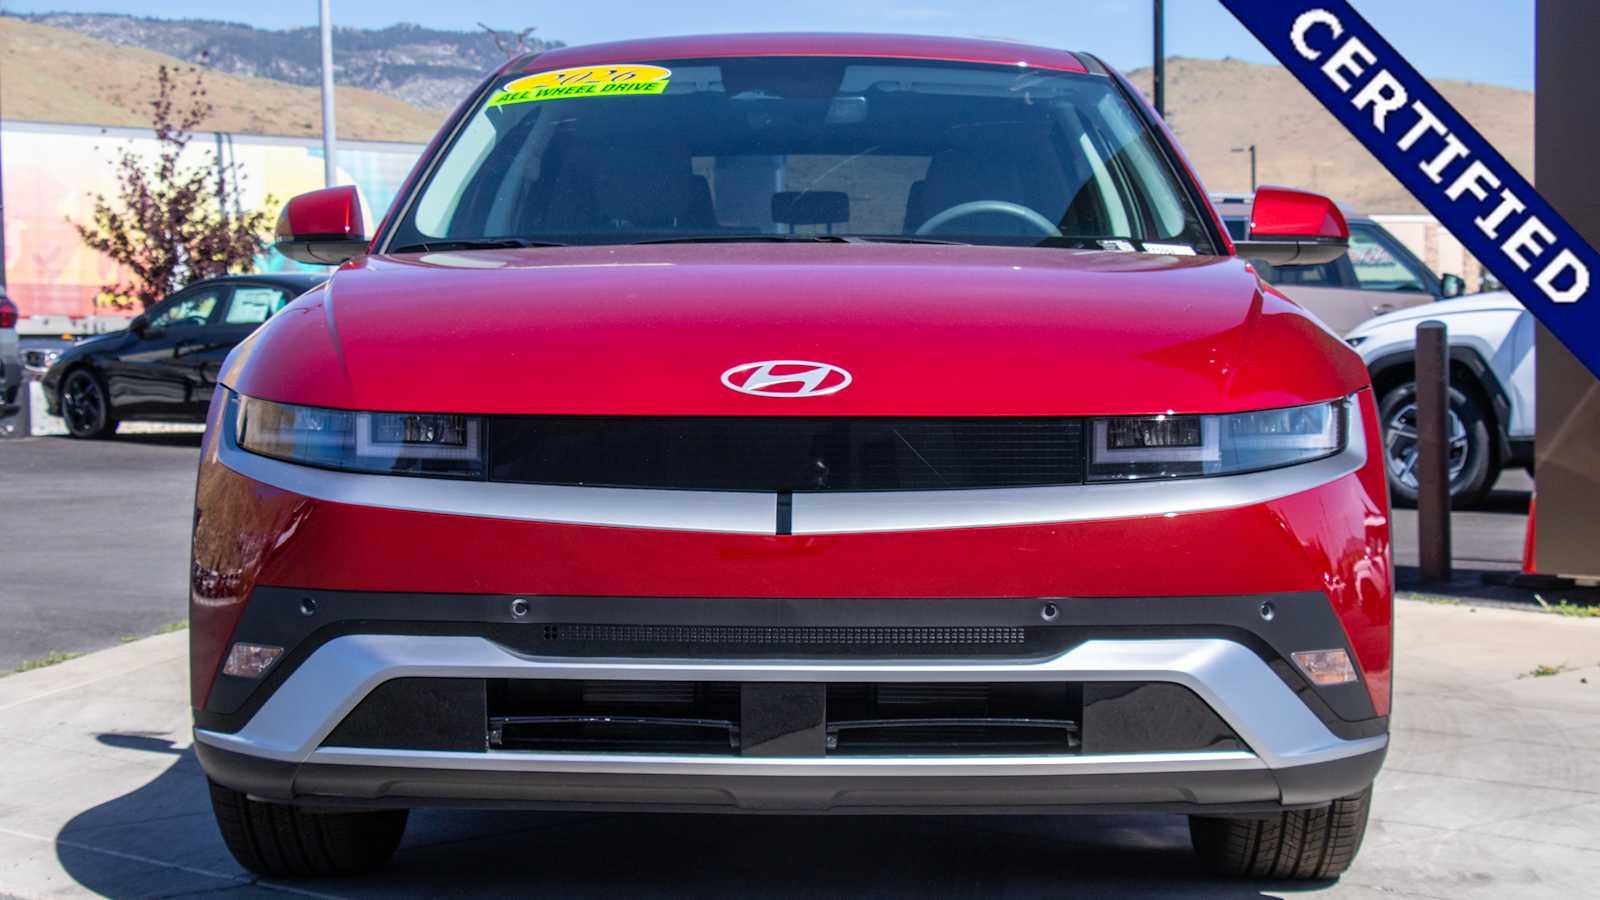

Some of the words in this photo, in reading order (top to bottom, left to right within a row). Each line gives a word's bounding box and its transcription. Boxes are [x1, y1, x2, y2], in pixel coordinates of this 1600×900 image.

[497, 90, 530, 103] ALL
[535, 84, 595, 97] WHEEL
[601, 81, 662, 93] DRIVE
